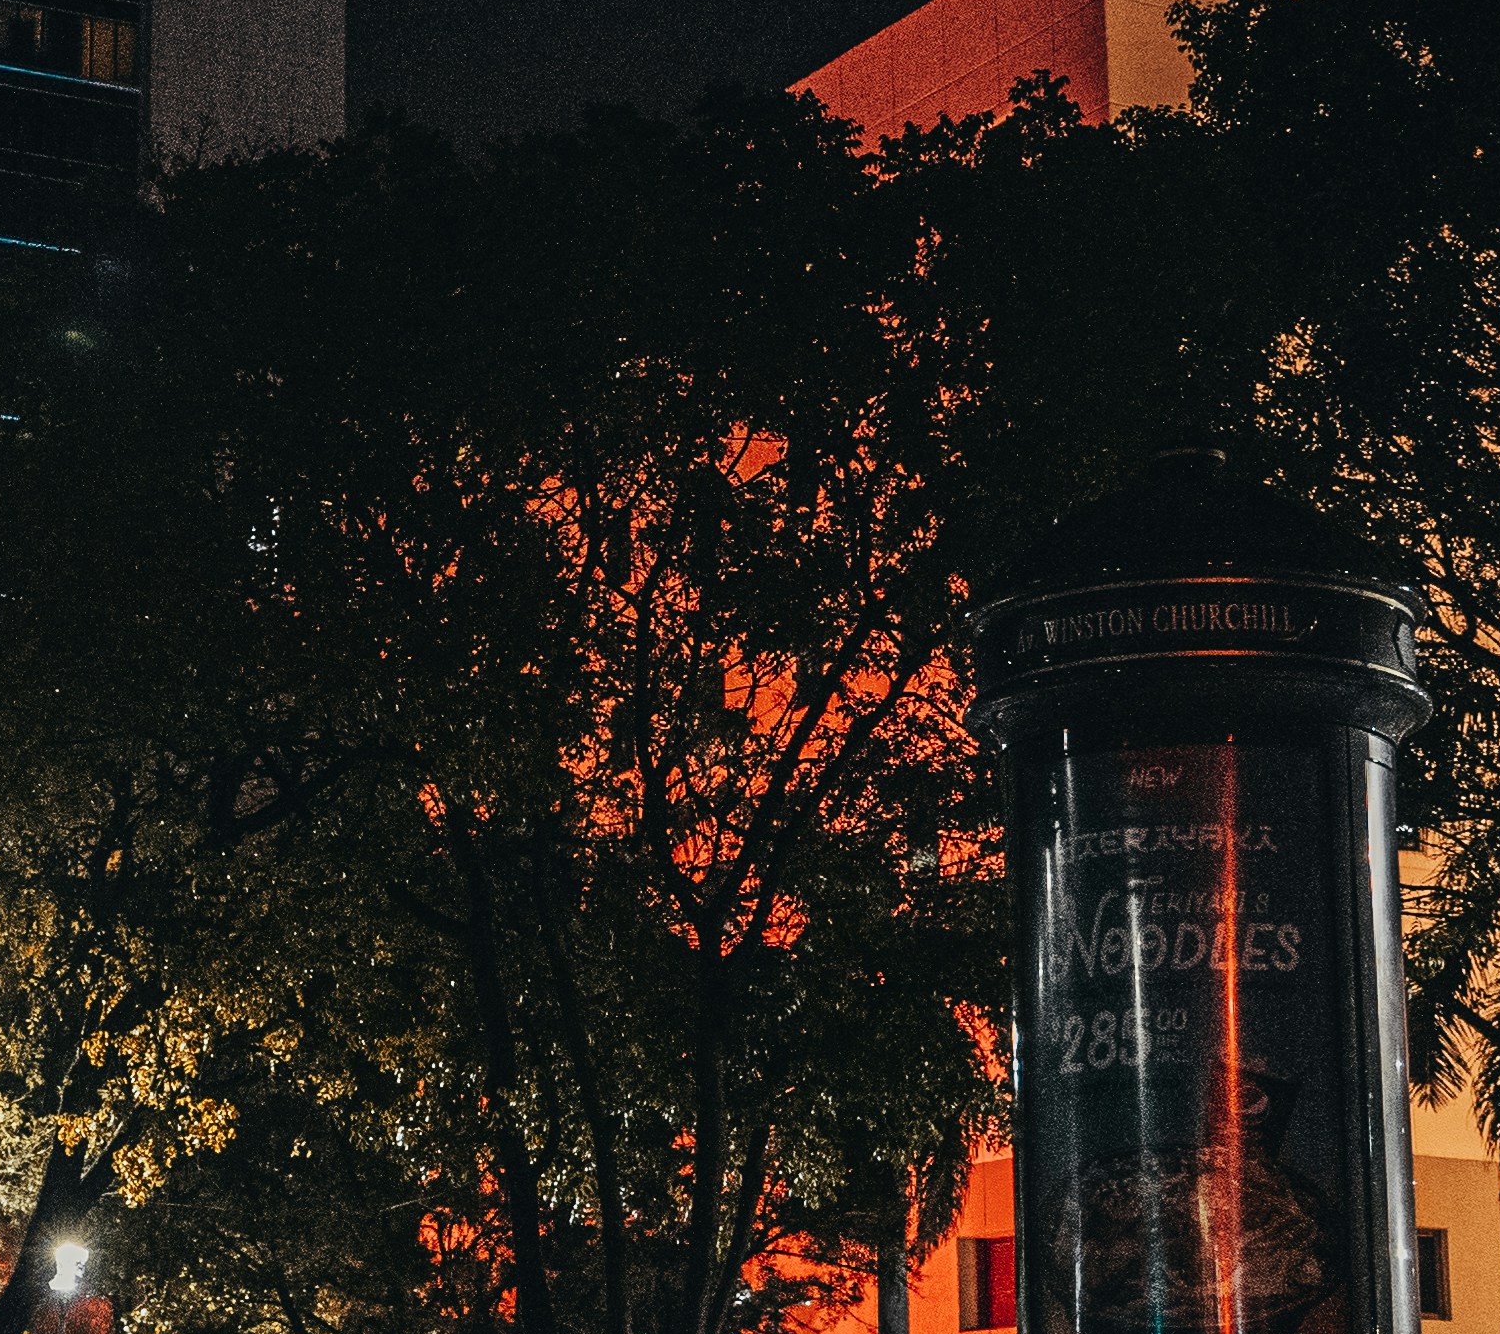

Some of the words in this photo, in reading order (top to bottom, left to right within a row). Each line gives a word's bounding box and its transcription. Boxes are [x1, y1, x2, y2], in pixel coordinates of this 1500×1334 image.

[1043, 607, 1145, 646] WINSTON
[1151, 601, 1297, 634] CHURCHILL
[1127, 765, 1184, 789] NEW
[1049, 890, 1302, 978] NOODLES
